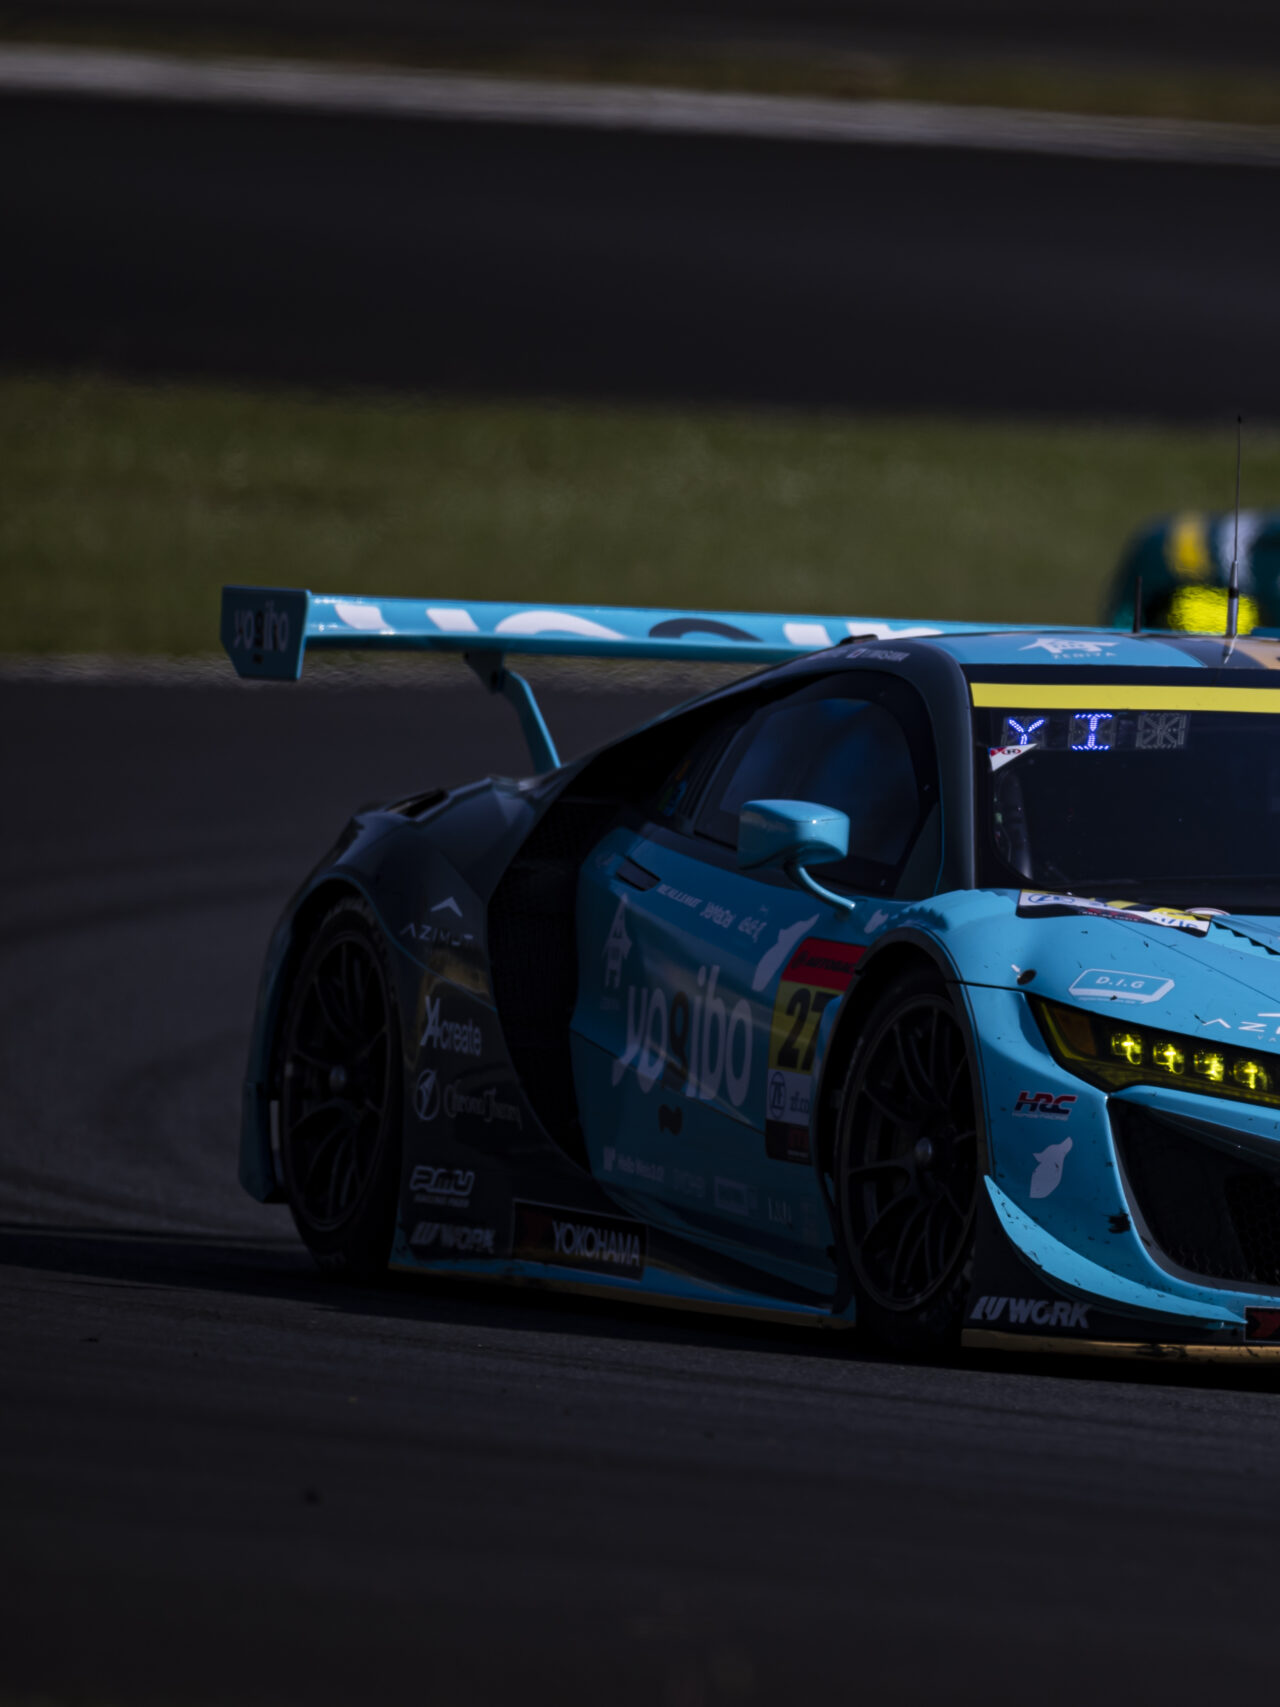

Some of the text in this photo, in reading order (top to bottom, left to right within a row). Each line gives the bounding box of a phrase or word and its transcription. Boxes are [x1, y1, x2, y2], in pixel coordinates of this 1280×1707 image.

[611, 964, 754, 1135] yogibo
[777, 986, 840, 1072] 27
[1014, 1090, 1078, 1115] HRC
[552, 1219, 642, 1267] YOKOHAMA
[1008, 1297, 1091, 1329] WORK
